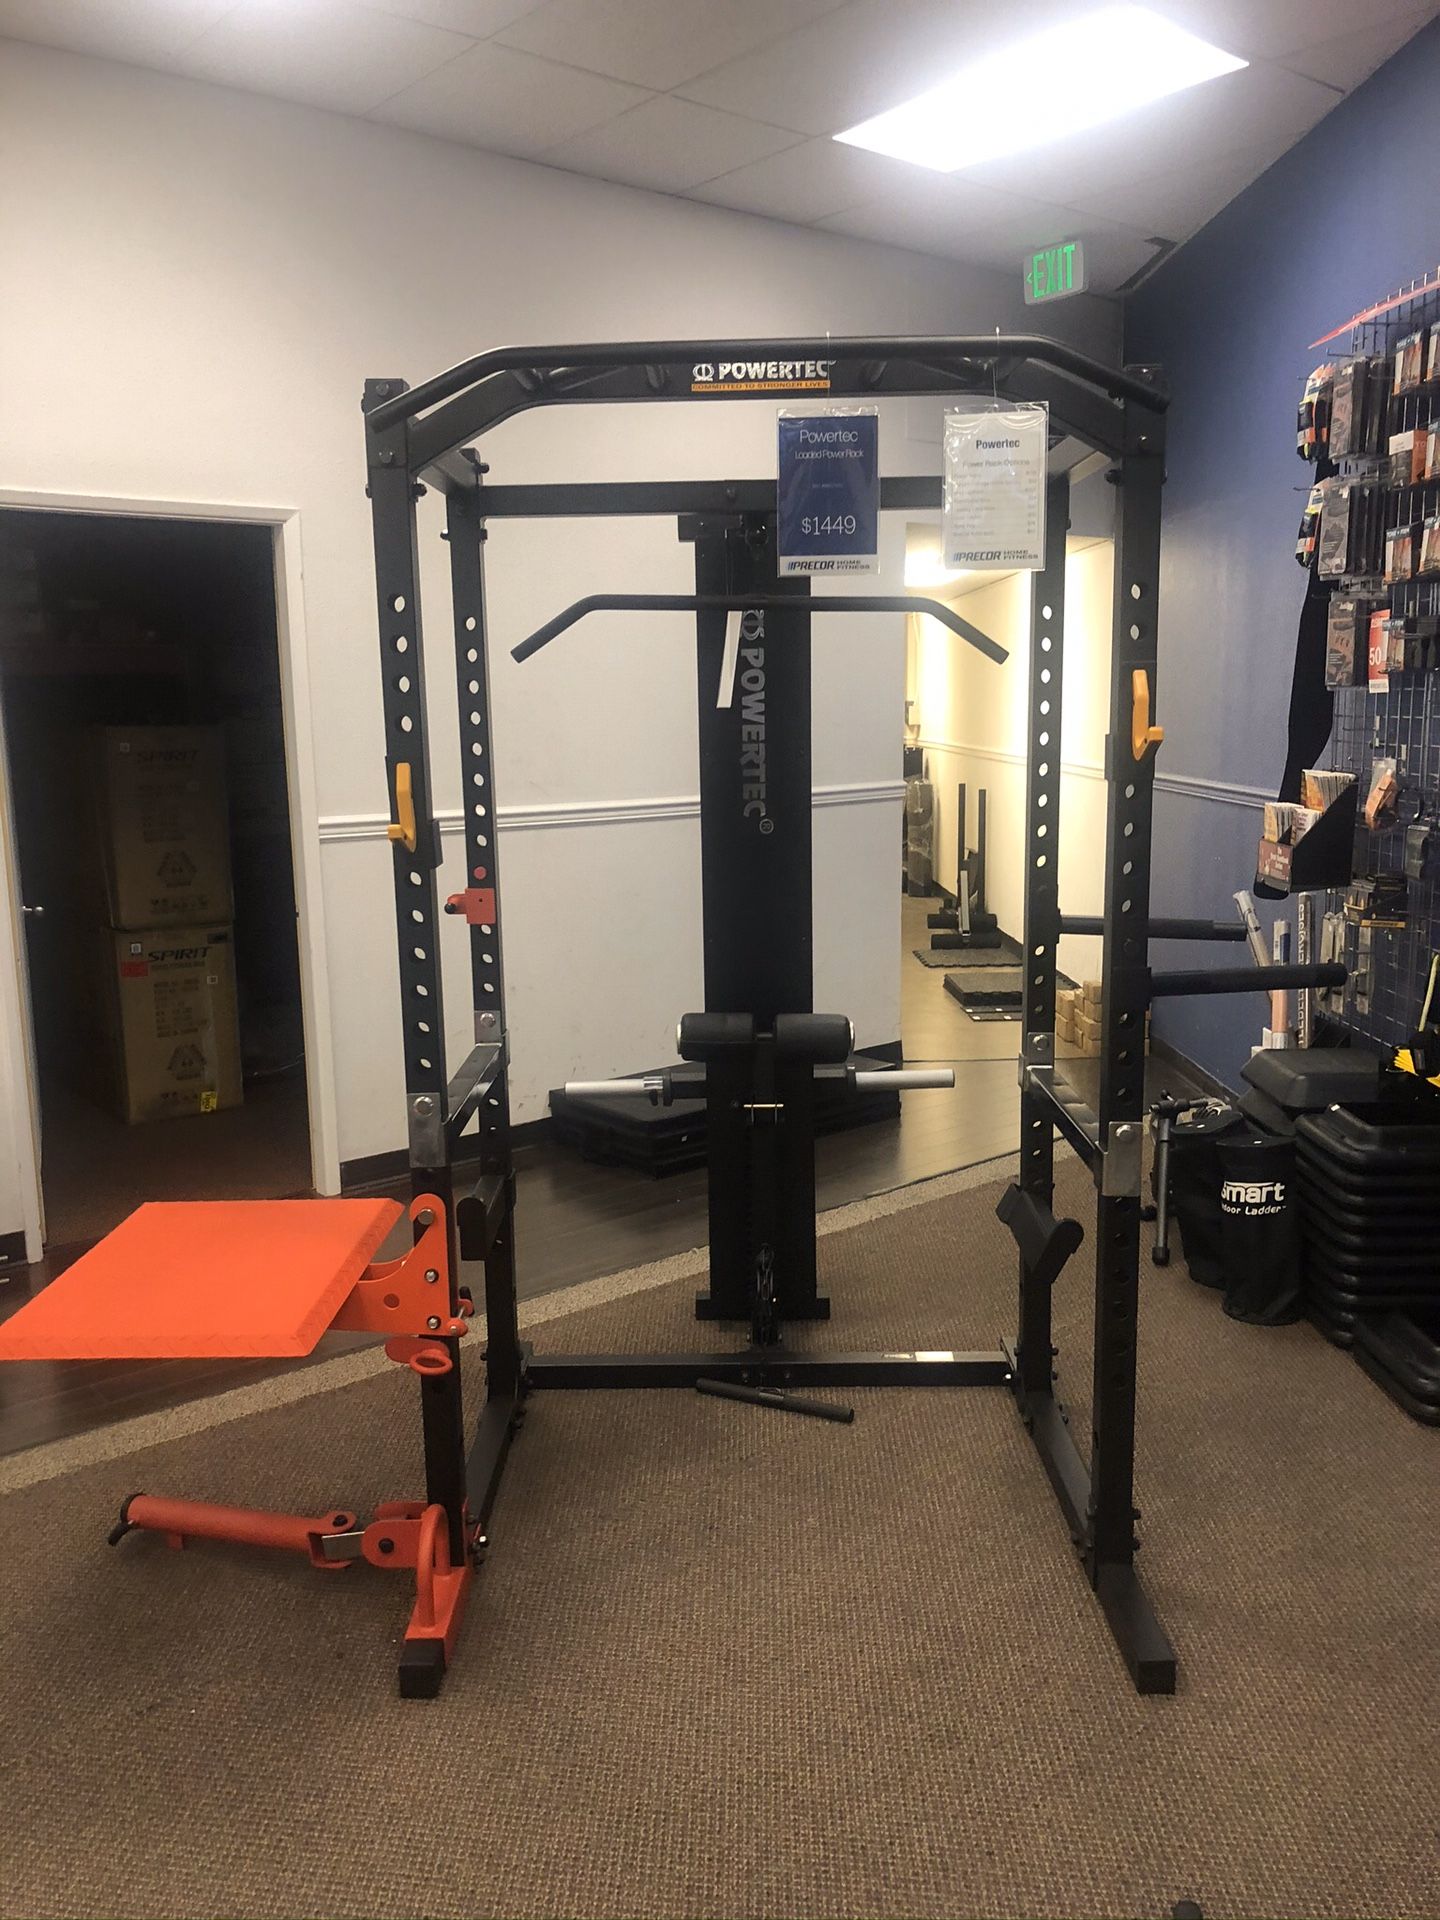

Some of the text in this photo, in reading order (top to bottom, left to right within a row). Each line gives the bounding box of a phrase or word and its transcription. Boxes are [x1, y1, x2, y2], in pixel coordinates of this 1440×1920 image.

[1032, 243, 1076, 298] EXIT
[718, 360, 829, 380] POWERTEC
[692, 382, 742, 391] COMMITTED
[757, 381, 803, 389] STRONGER
[805, 380, 828, 388] LIVES
[799, 429, 858, 443] Powertec
[976, 439, 1020, 450] Powertec
[801, 515, 856, 535] $1449
[958, 551, 1001, 562] PRECOR
[792, 560, 835, 570] PRECOR
[740, 647, 767, 819] POWERTEC
[147, 946, 212, 962] SPIRIT
[1245, 1205, 1281, 1216] Ladder
